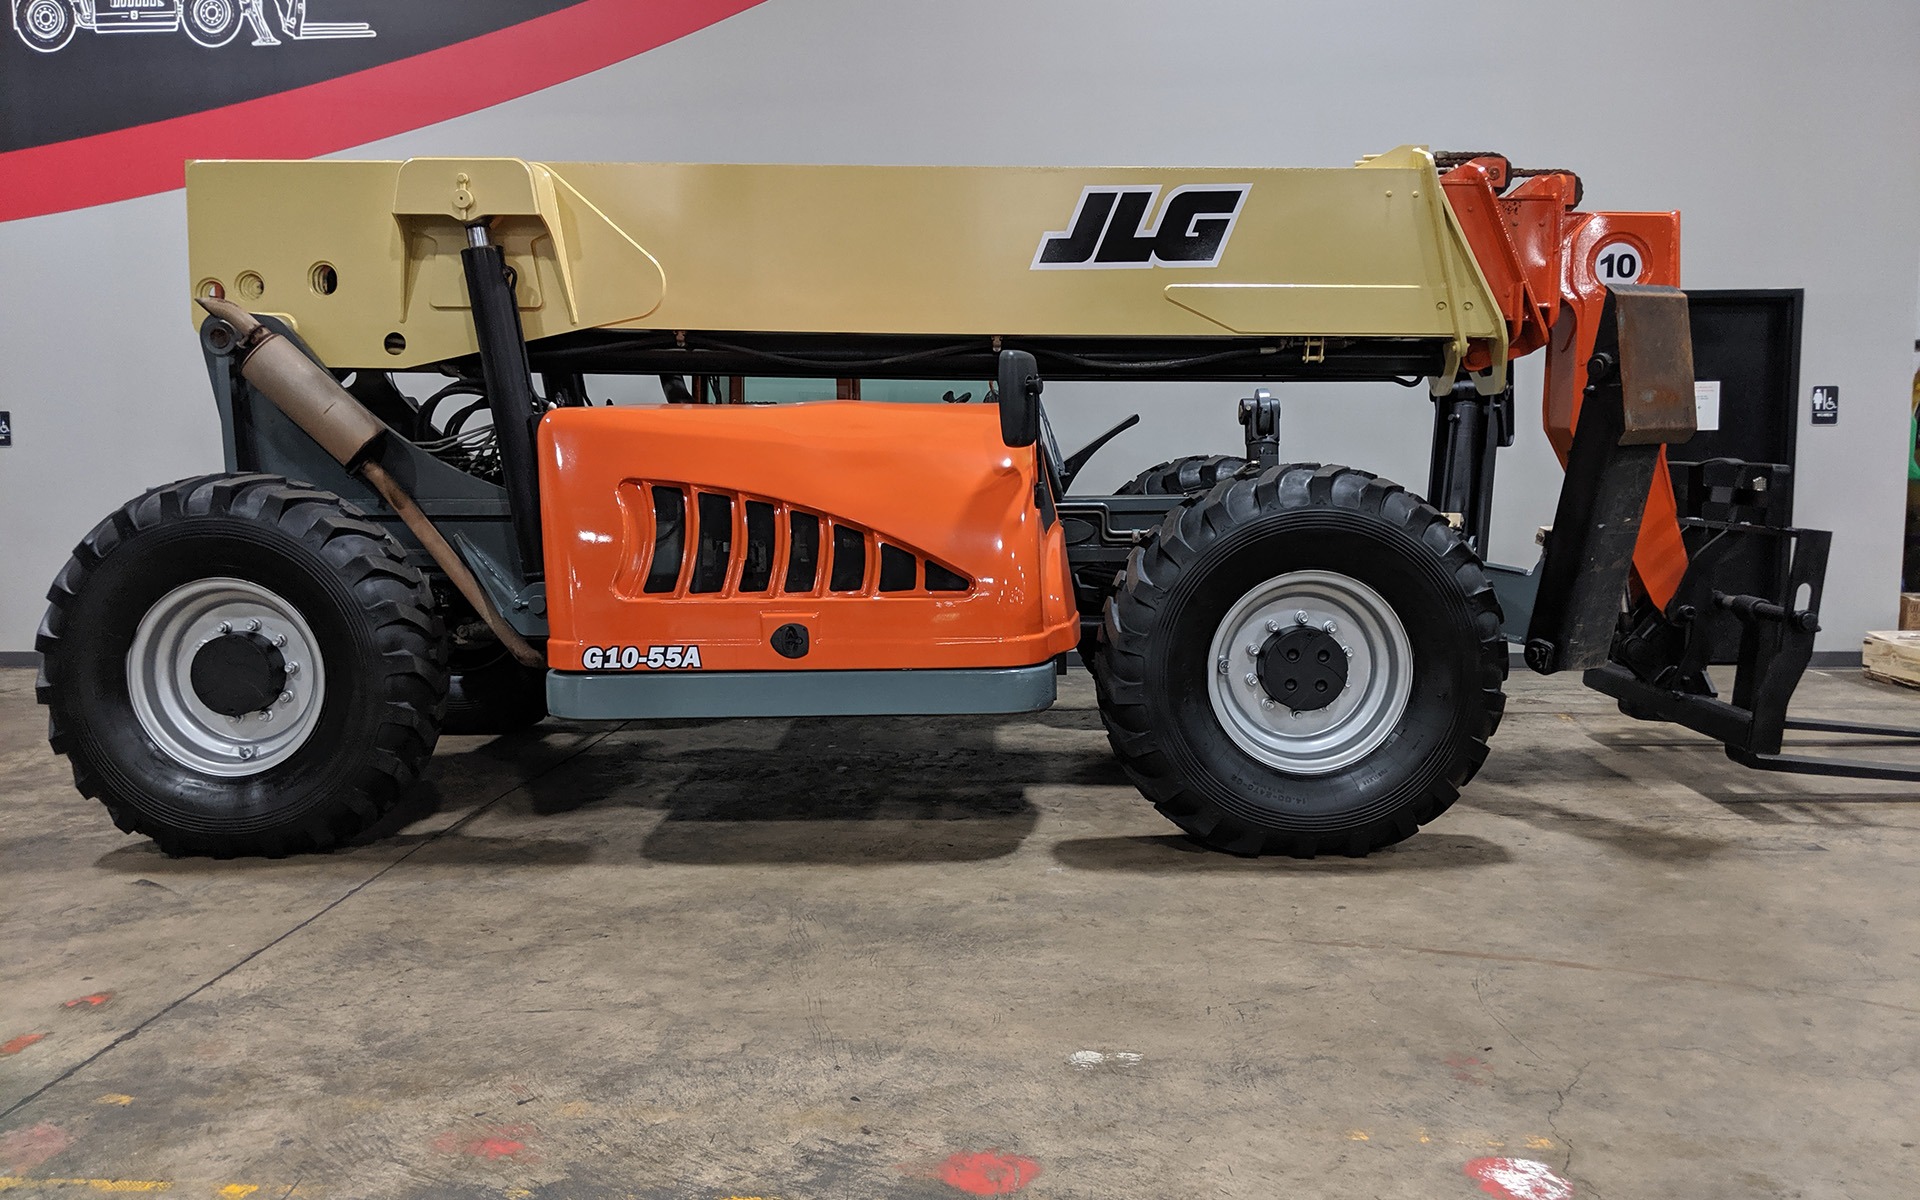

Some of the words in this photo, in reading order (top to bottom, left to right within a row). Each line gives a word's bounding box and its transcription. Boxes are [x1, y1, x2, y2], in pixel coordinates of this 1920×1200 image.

[1038, 189, 1245, 264] JLG
[1600, 253, 1636, 278] 10
[582, 645, 703, 669] G10-55A
